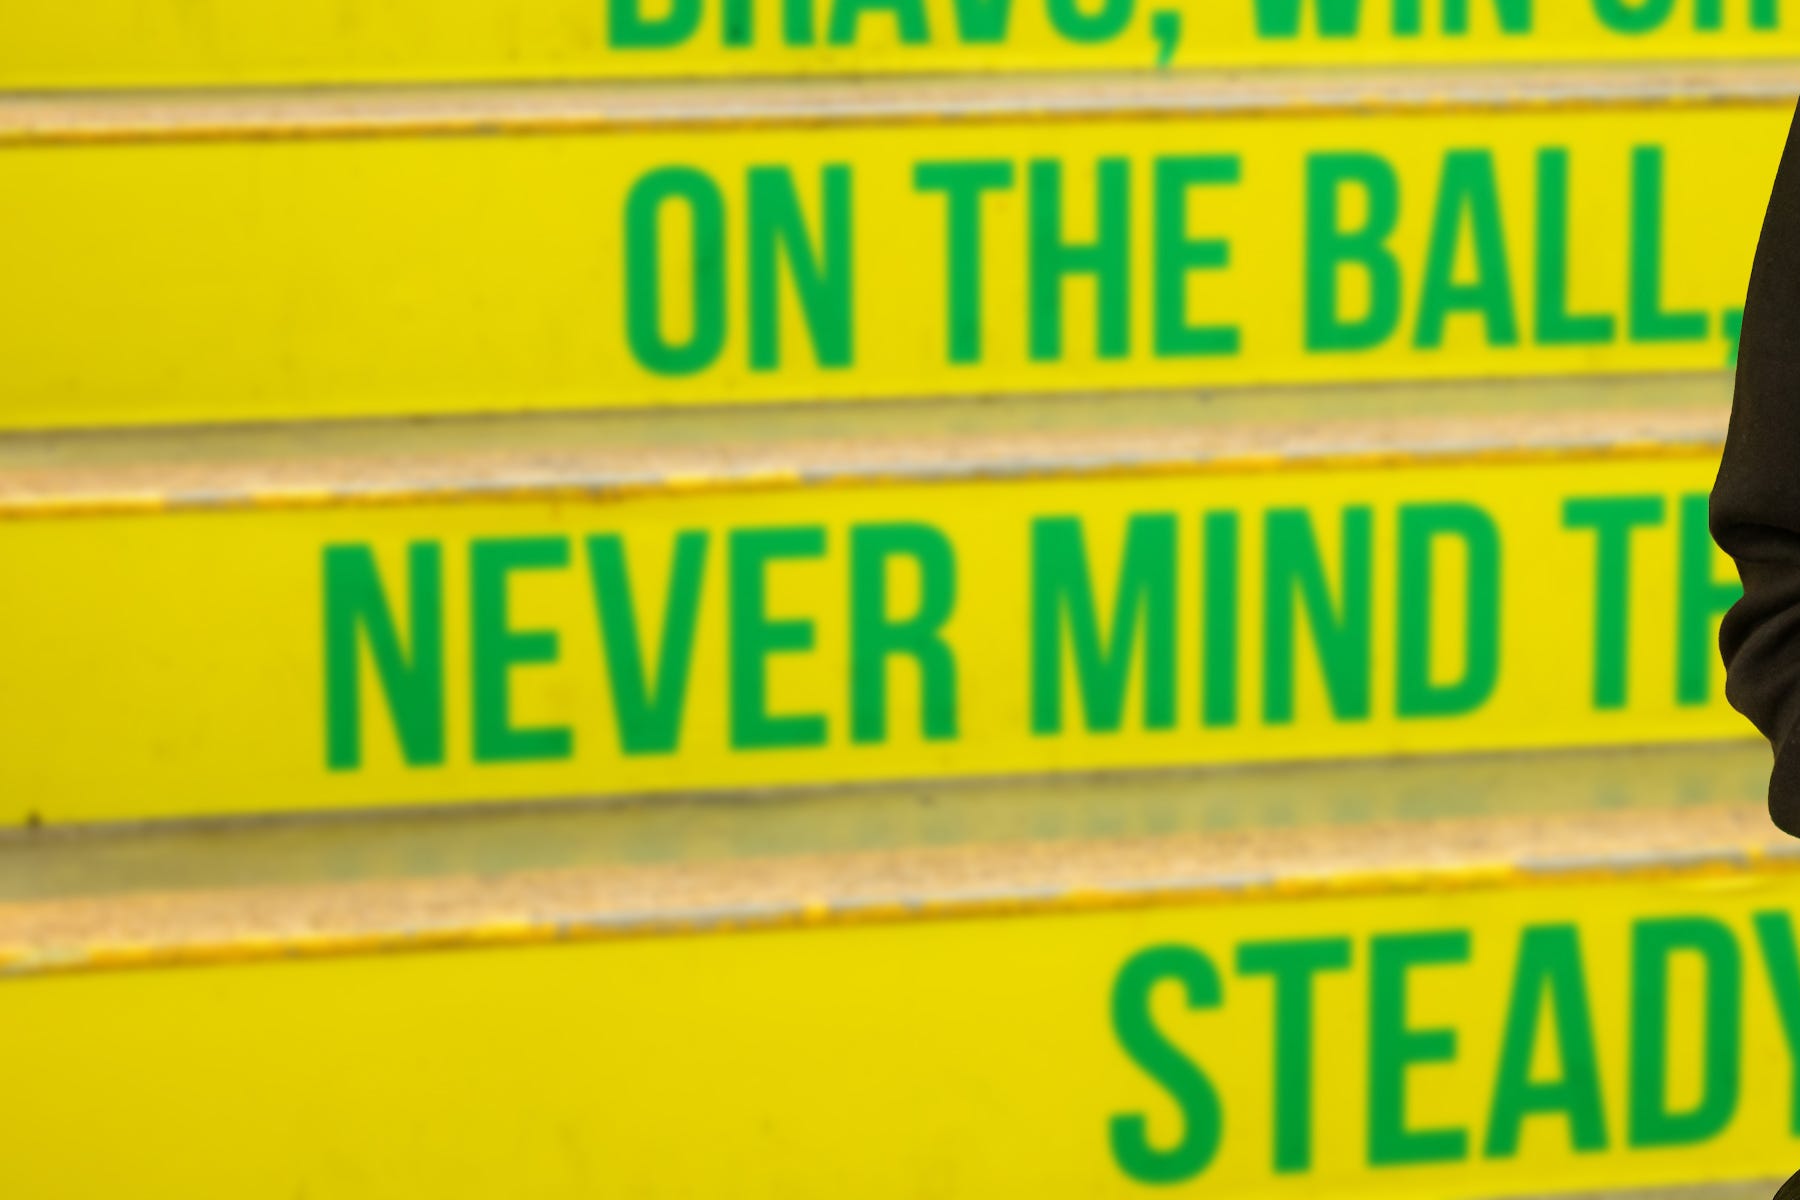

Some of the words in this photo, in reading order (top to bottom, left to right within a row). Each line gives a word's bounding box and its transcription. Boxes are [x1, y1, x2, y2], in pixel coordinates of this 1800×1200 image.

[624, 163, 854, 377] ON
[913, 154, 1241, 365] THE
[323, 521, 958, 771] NEVER
[1031, 502, 1501, 736] MIND
[1562, 493, 1746, 710] TH
